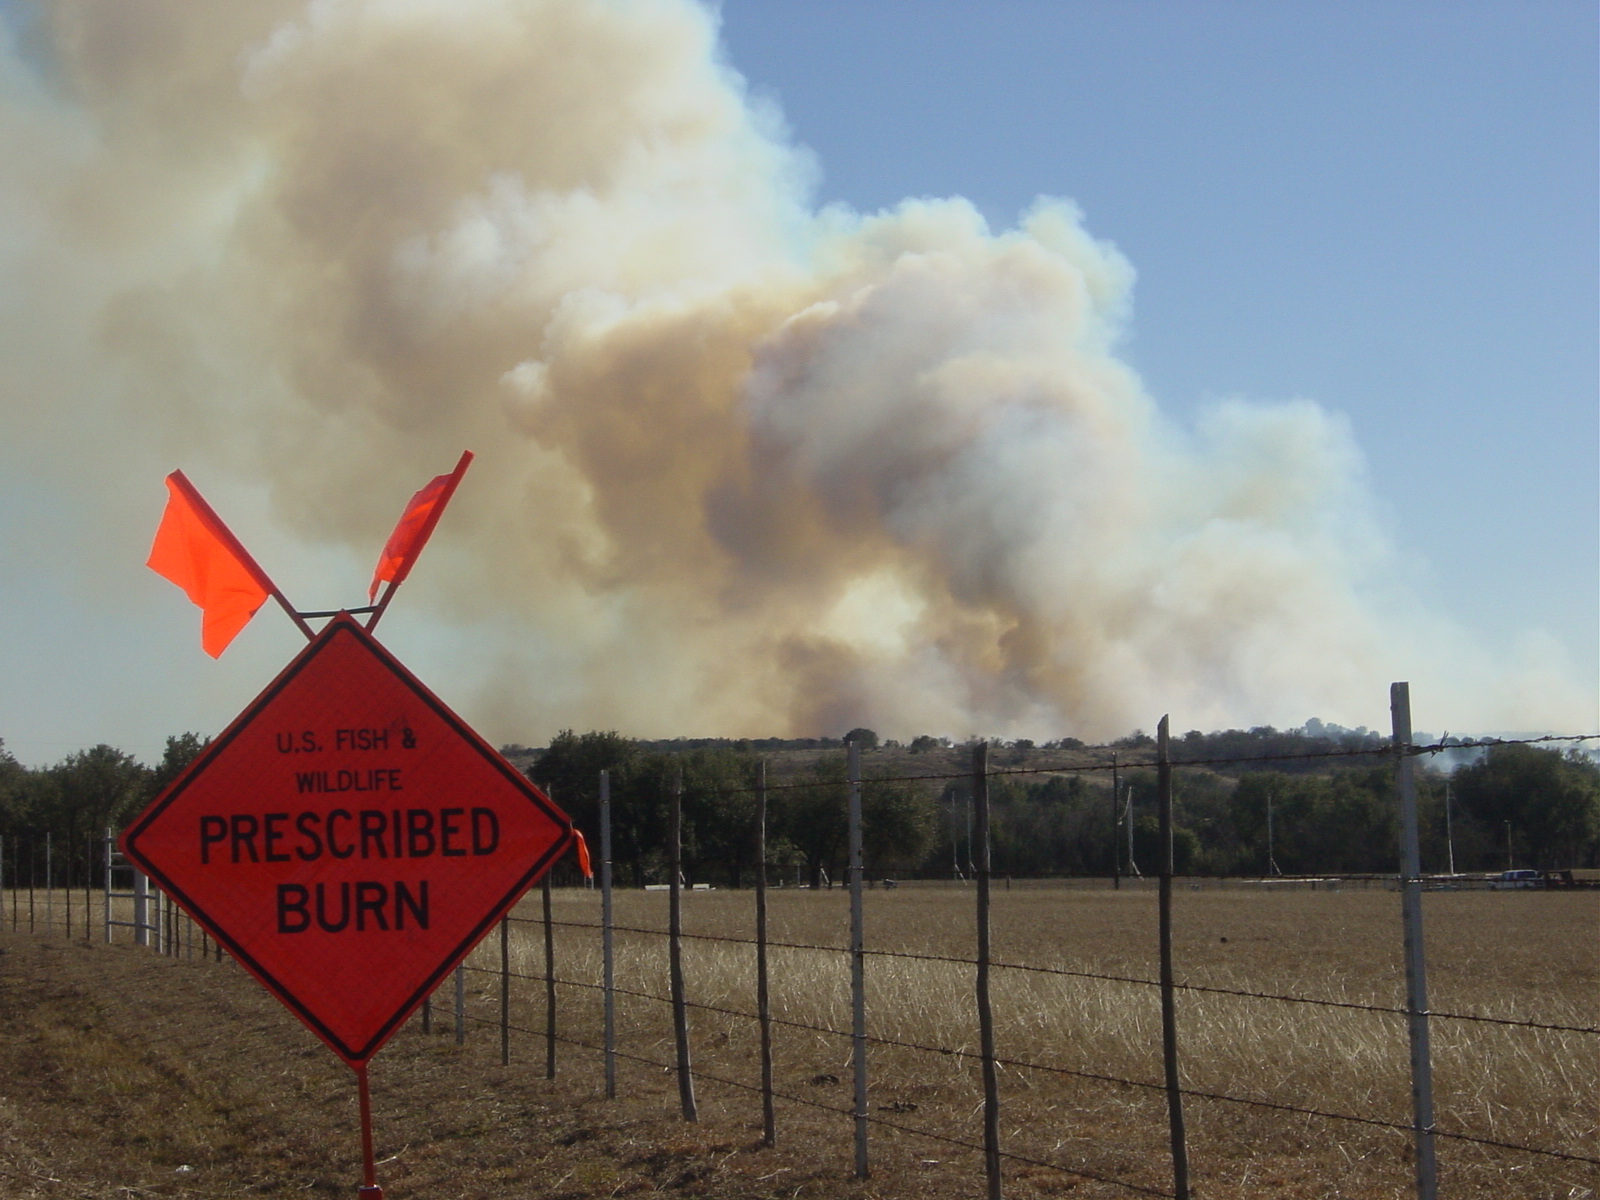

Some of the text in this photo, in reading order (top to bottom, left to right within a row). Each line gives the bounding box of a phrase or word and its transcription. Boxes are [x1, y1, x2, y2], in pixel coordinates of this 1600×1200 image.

[276, 728, 417, 754] U.S. FISH &
[296, 769, 402, 794] WILDLIFE
[200, 807, 500, 864] PRESCRIBED
[277, 880, 430, 934] BURN
